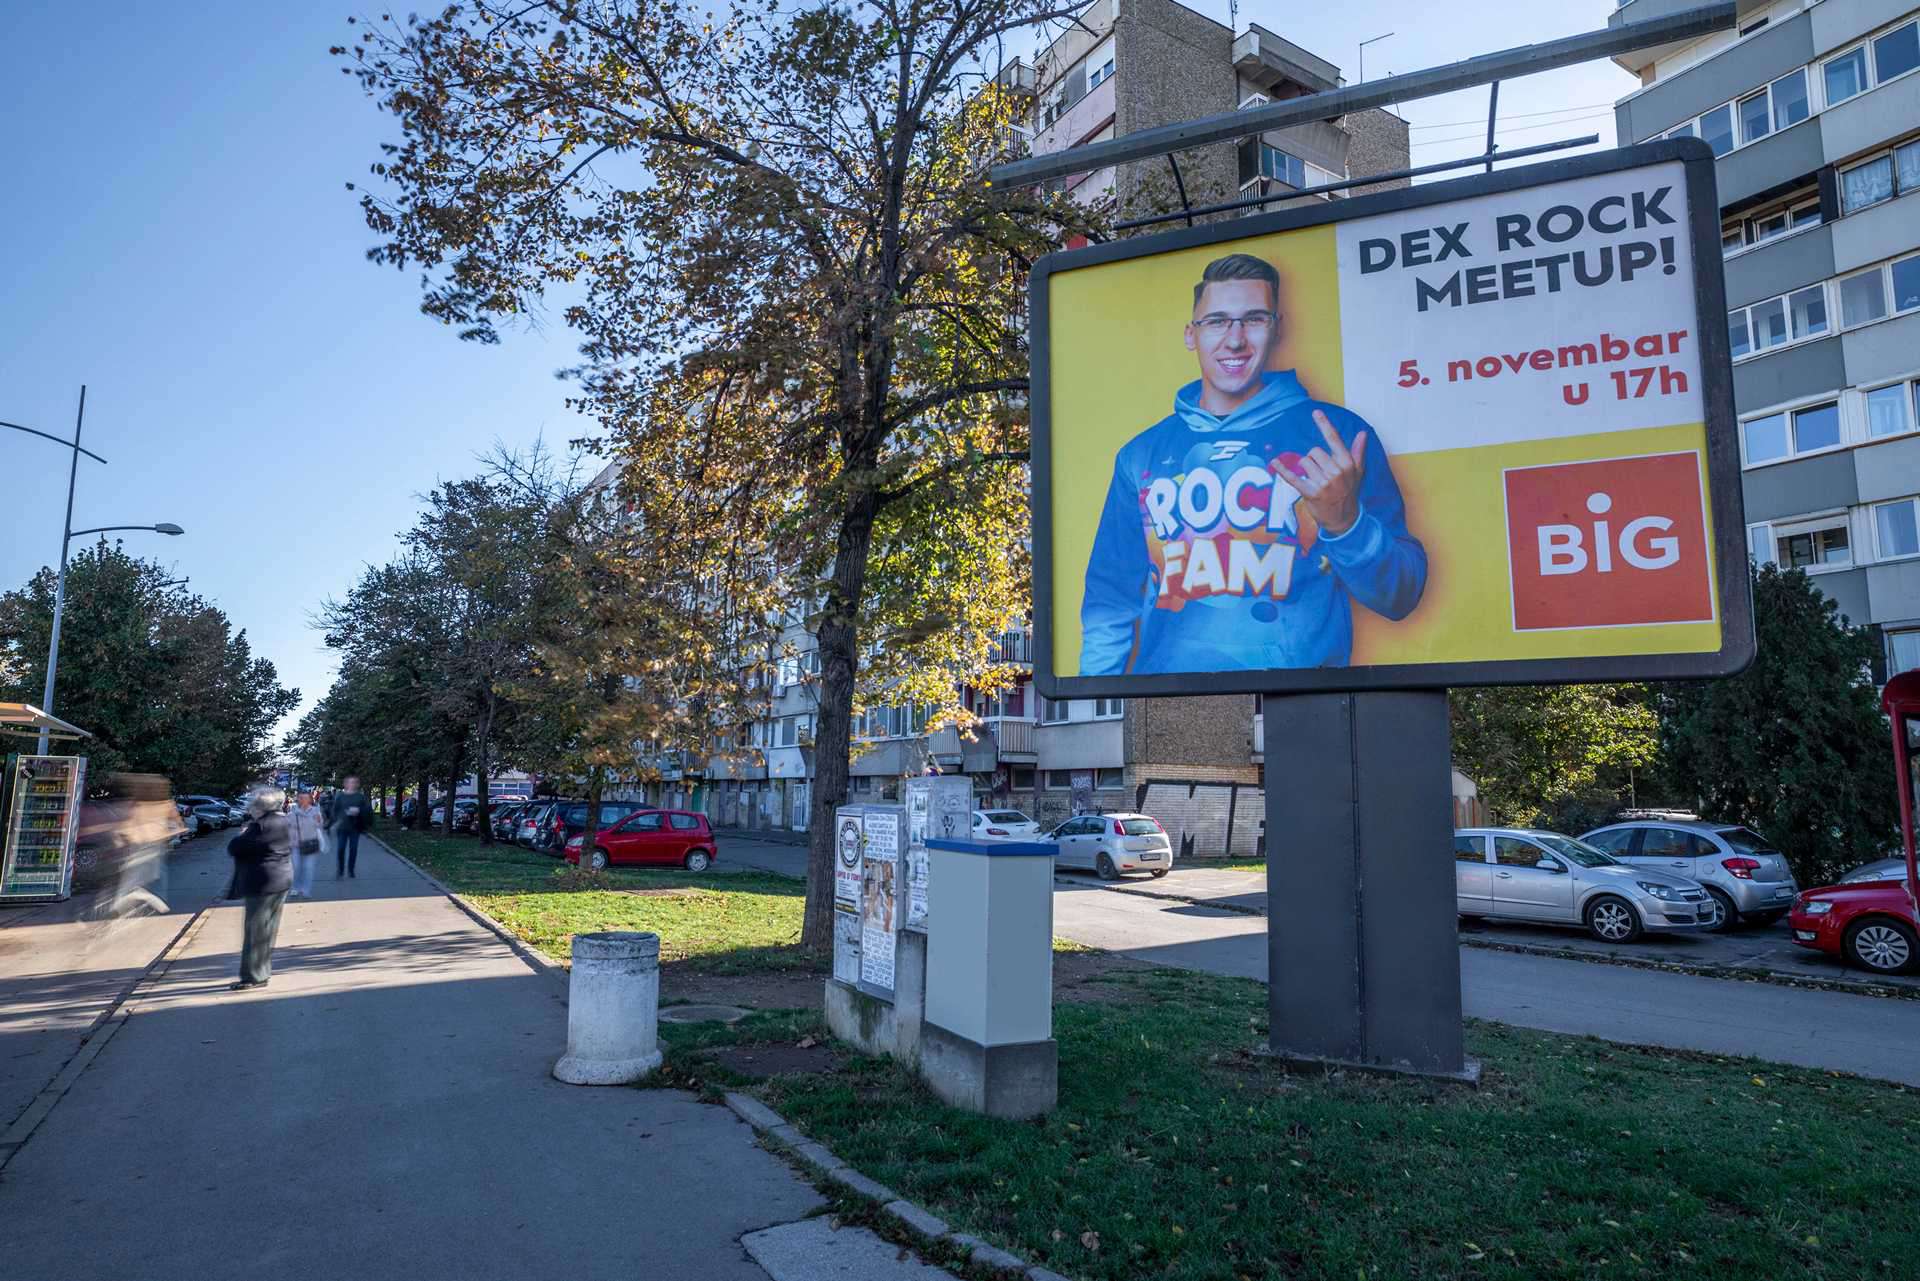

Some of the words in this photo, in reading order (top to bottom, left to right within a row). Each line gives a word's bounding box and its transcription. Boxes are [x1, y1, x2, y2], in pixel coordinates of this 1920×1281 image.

[1358, 221, 1473, 275] DEX
[1495, 186, 1677, 253] ROCK
[1415, 236, 1677, 312] MEETUP!
[1398, 360, 1430, 388] 5.
[1447, 330, 1688, 382] novembar
[1563, 381, 1589, 405] u
[1611, 364, 1688, 401] 17h
[1144, 465, 1303, 538] ROCK
[1158, 537, 1297, 598] FAM
